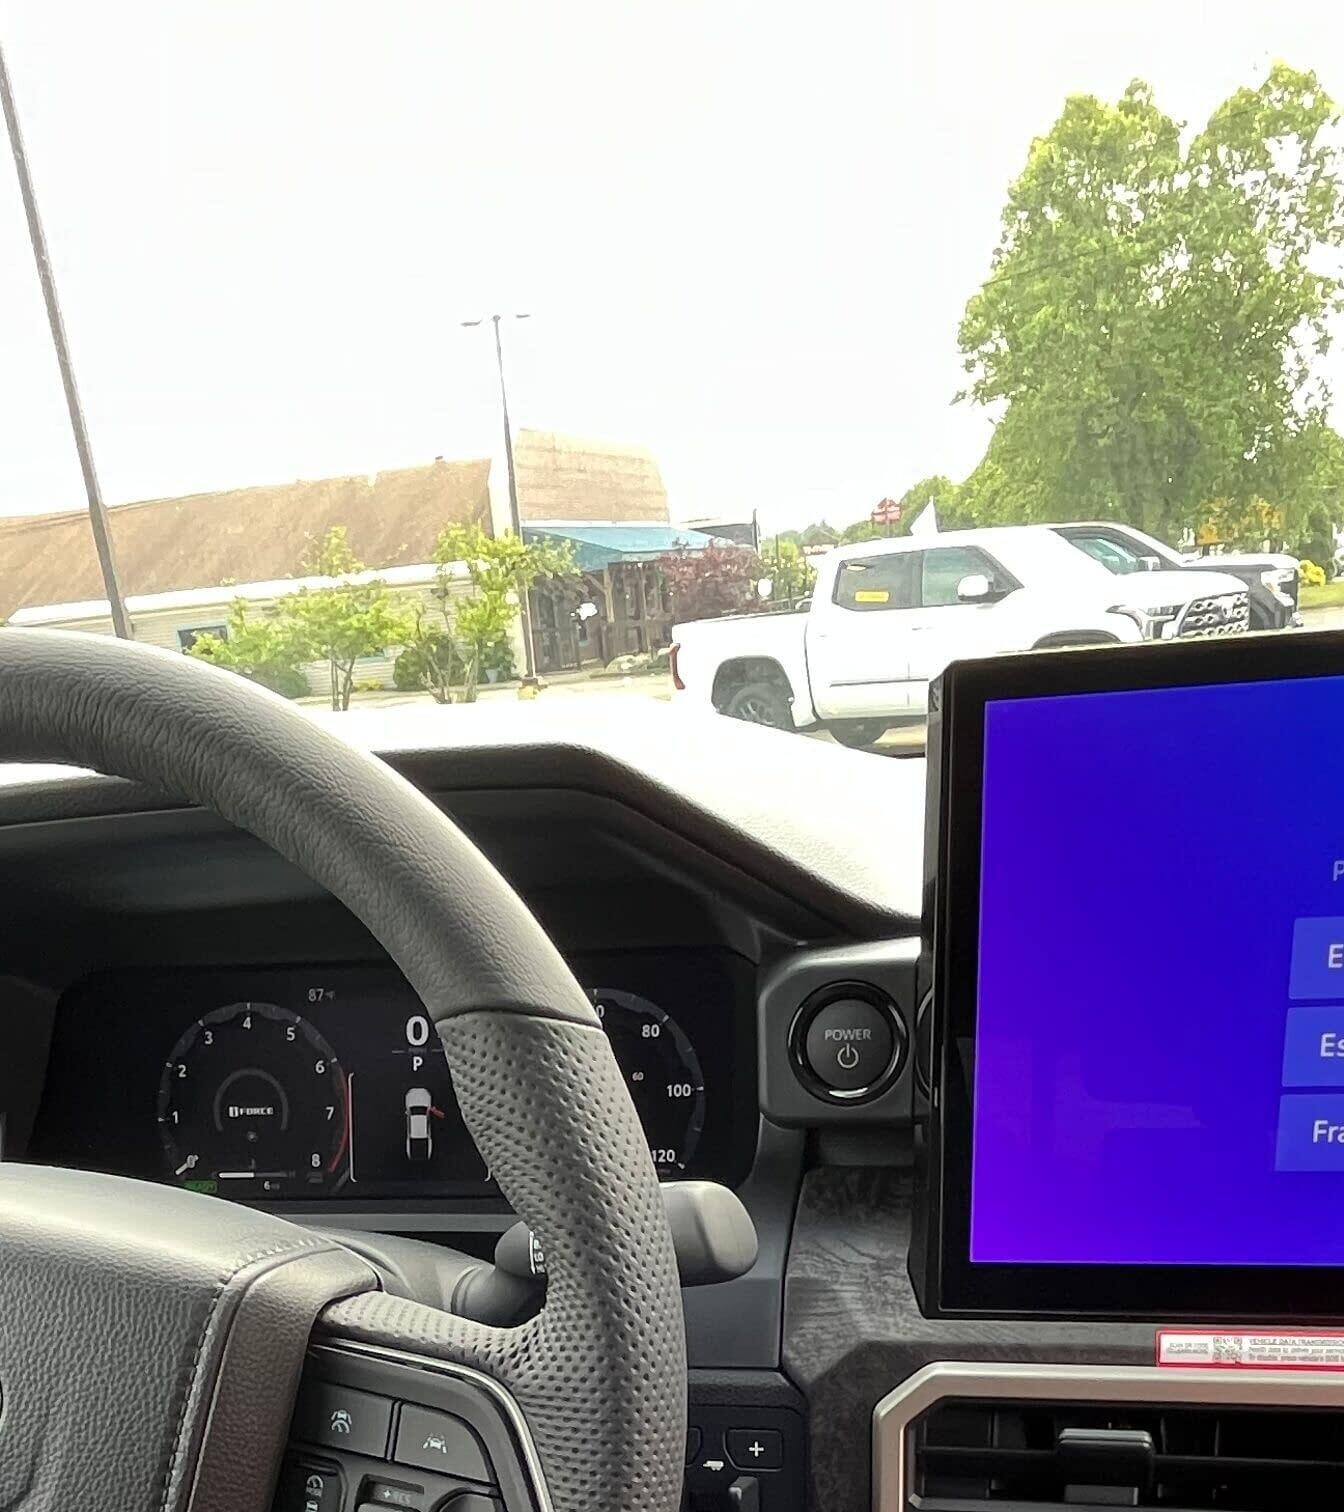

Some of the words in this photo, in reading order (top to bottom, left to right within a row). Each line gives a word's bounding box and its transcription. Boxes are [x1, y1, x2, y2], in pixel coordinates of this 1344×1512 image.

[242, 1016, 252, 1030] 4
[286, 1027, 296, 1042] 5
[406, 1015, 429, 1046] 0
[641, 1024, 660, 1038] 80
[824, 1028, 872, 1041] POWER
[204, 1031, 214, 1045] 3
[178, 1064, 187, 1078] 2
[315, 1060, 325, 1074] 6
[412, 1056, 423, 1072] P
[666, 1084, 692, 1097] 100
[171, 1111, 180, 1124] 1
[325, 1106, 335, 1120] 7
[311, 1153, 321, 1168] 8
[651, 1149, 675, 1163] 120
